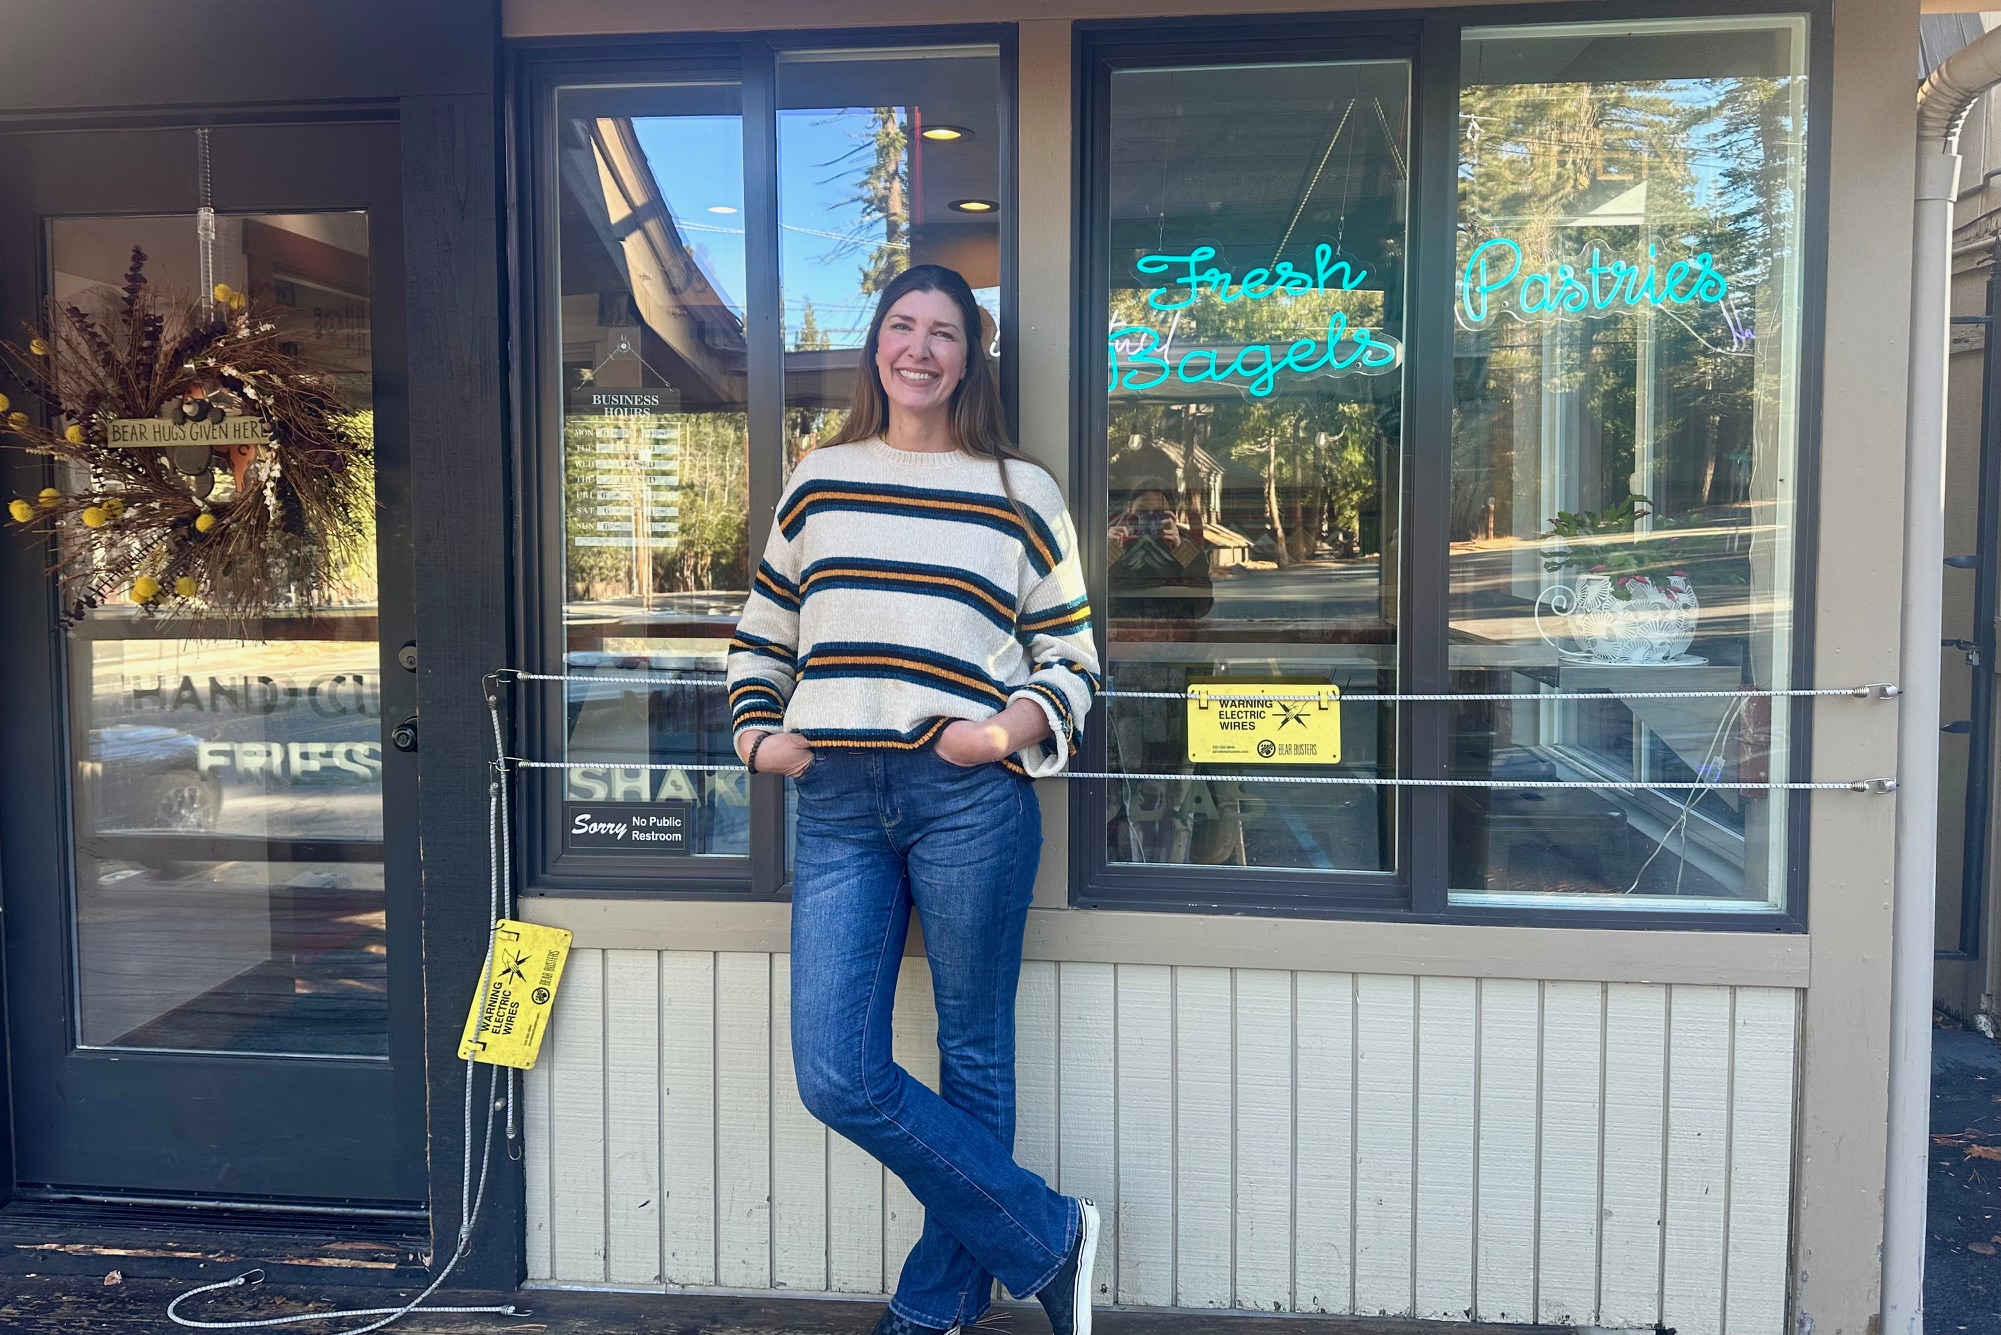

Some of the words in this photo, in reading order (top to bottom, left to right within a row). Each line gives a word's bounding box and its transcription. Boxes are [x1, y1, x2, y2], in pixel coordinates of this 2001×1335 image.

[1136, 243, 1367, 311] Fresh
[1463, 237, 1727, 322] Pastries
[1108, 311, 1396, 397] Bagels
[592, 394, 660, 406] BUSINESS
[603, 407, 651, 418] HOURS
[112, 424, 149, 442] BEAR
[152, 424, 186, 442] HUGS
[189, 422, 228, 442] GIVEN
[574, 429, 594, 437] MON
[574, 444, 594, 452] TUE
[574, 460, 595, 468] WED
[618, 460, 656, 468] CLOSED
[619, 476, 656, 484] CLOSED
[575, 491, 594, 499] FRI
[125, 674, 380, 718] HAND-CU
[1219, 699, 1273, 709] WARNING
[1219, 710, 1266, 720] ELECTRIC
[1219, 721, 1256, 731] WIRES
[1278, 744, 1293, 756] BEAR
[1293, 744, 1317, 756] BUSTERS
[197, 741, 381, 786] FRIES
[569, 768, 750, 807] SHAK
[571, 813, 628, 841] Sorry
[632, 816, 647, 827] No
[649, 816, 682, 828] Public
[632, 830, 682, 842] Restroom
[543, 949, 560, 973] BUSTERS
[539, 971, 553, 987] BEAR
[480, 981, 503, 1032] WARNING
[491, 989, 512, 1035] ELECTRIC
[502, 1001, 520, 1035] WIRES
